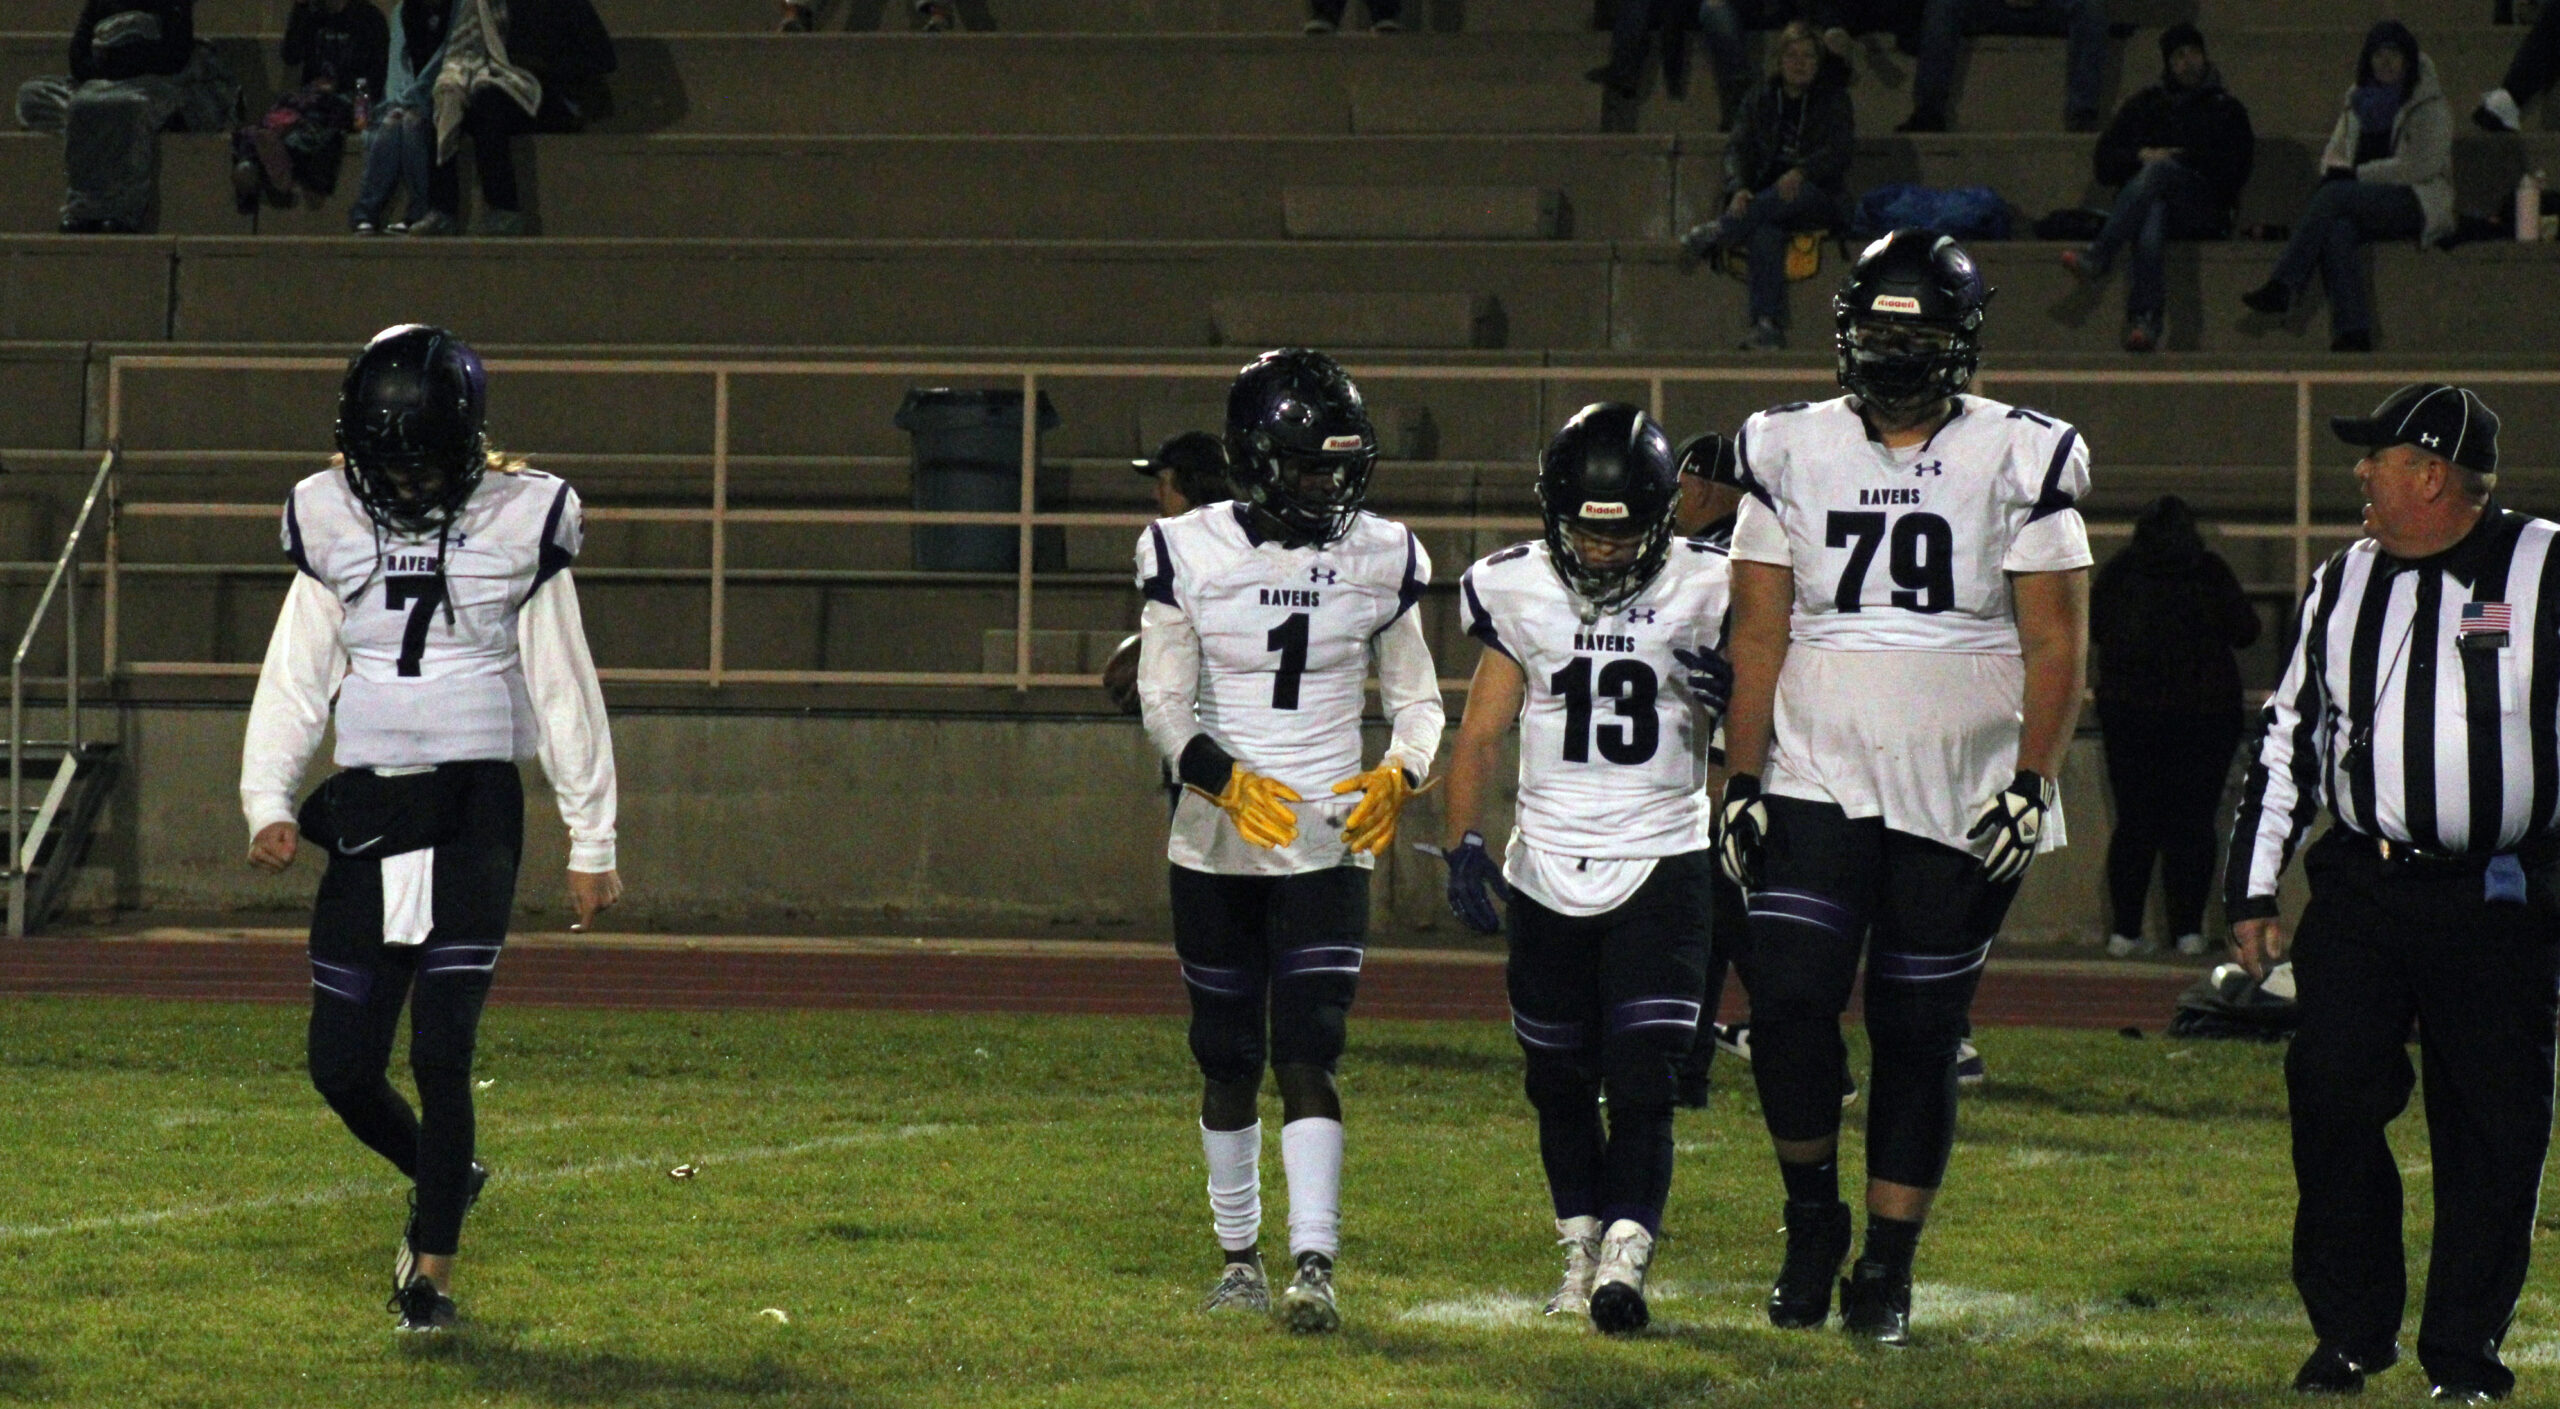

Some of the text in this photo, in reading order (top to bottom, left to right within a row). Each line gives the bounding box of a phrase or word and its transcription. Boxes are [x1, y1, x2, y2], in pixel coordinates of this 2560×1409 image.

[1859, 488, 1920, 505] RAVENS
[1585, 504, 1623, 514] Riddell
[387, 555, 438, 572] RAVEN
[1825, 510, 1955, 614] 79
[1260, 589, 1320, 607] RAVENS
[385, 576, 445, 677] 7
[1574, 634, 1636, 652] RAVENS
[1267, 612, 1310, 711] 1
[1551, 657, 1660, 765] 13
